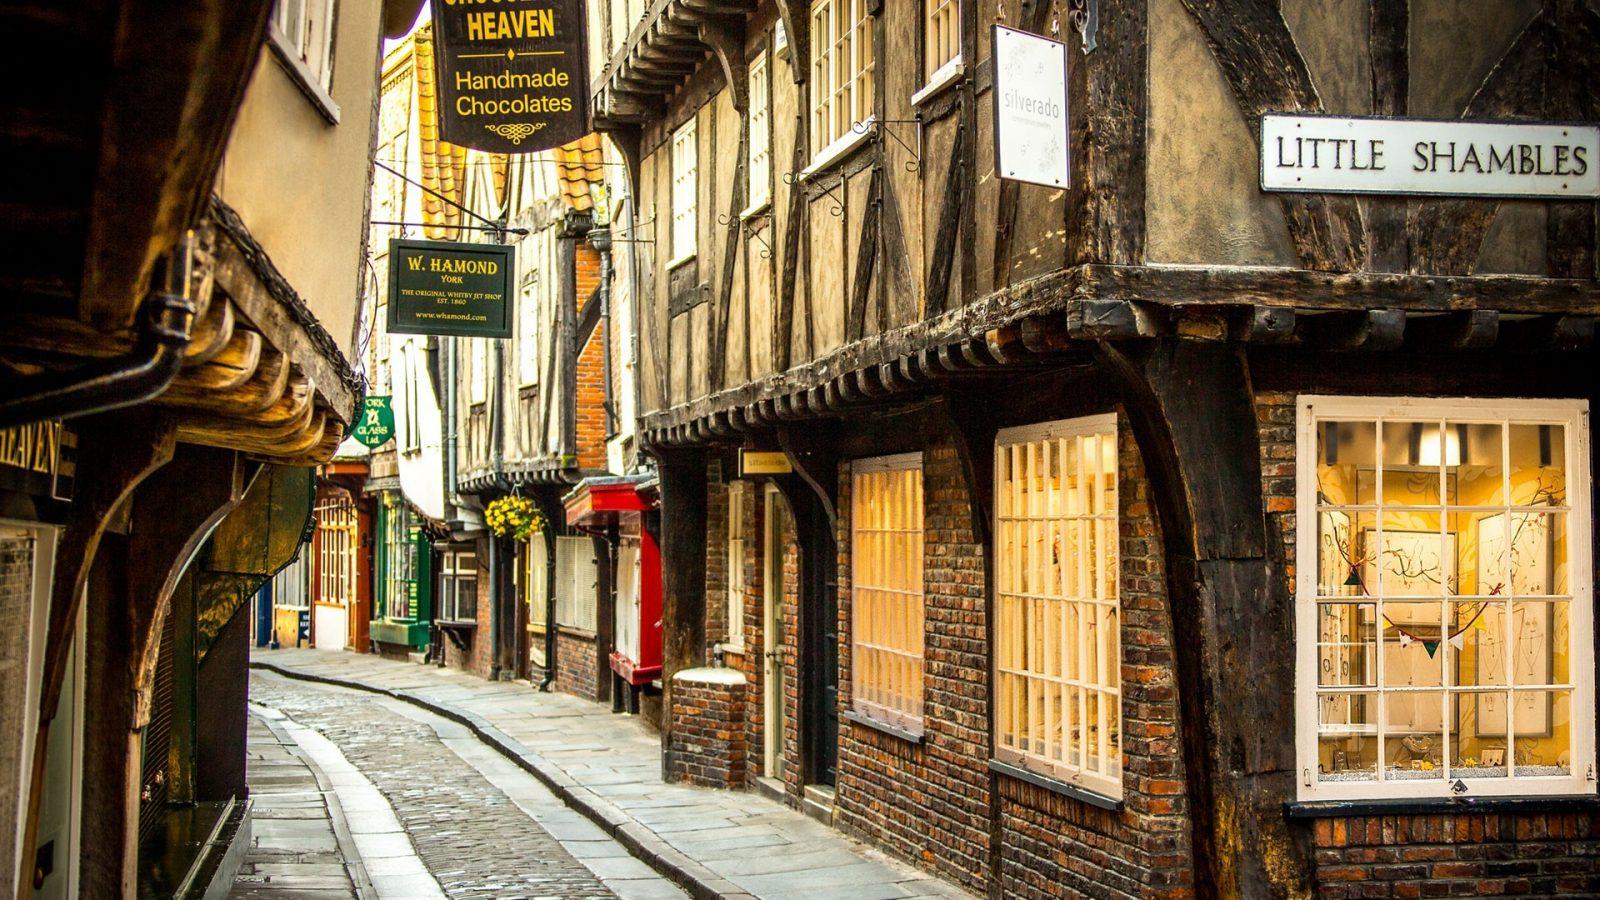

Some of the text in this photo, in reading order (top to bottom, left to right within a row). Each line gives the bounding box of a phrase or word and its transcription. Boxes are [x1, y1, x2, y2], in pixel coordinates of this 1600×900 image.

[467, 9, 555, 41] HEAVEN
[455, 67, 569, 91] Handmade
[456, 94, 573, 116] Chocolates
[1004, 88, 1060, 119] silverado
[1275, 135, 1588, 177] LITTLE SHAMBLES
[407, 255, 498, 275] W. HAMOND
[440, 274, 463, 284] YORK
[447, 291, 473, 299] WHITBY
[473, 292, 483, 300] JET
[415, 312, 487, 321] www.whamond.com
[365, 398, 386, 408] ORK
[357, 426, 388, 435] GLASS
